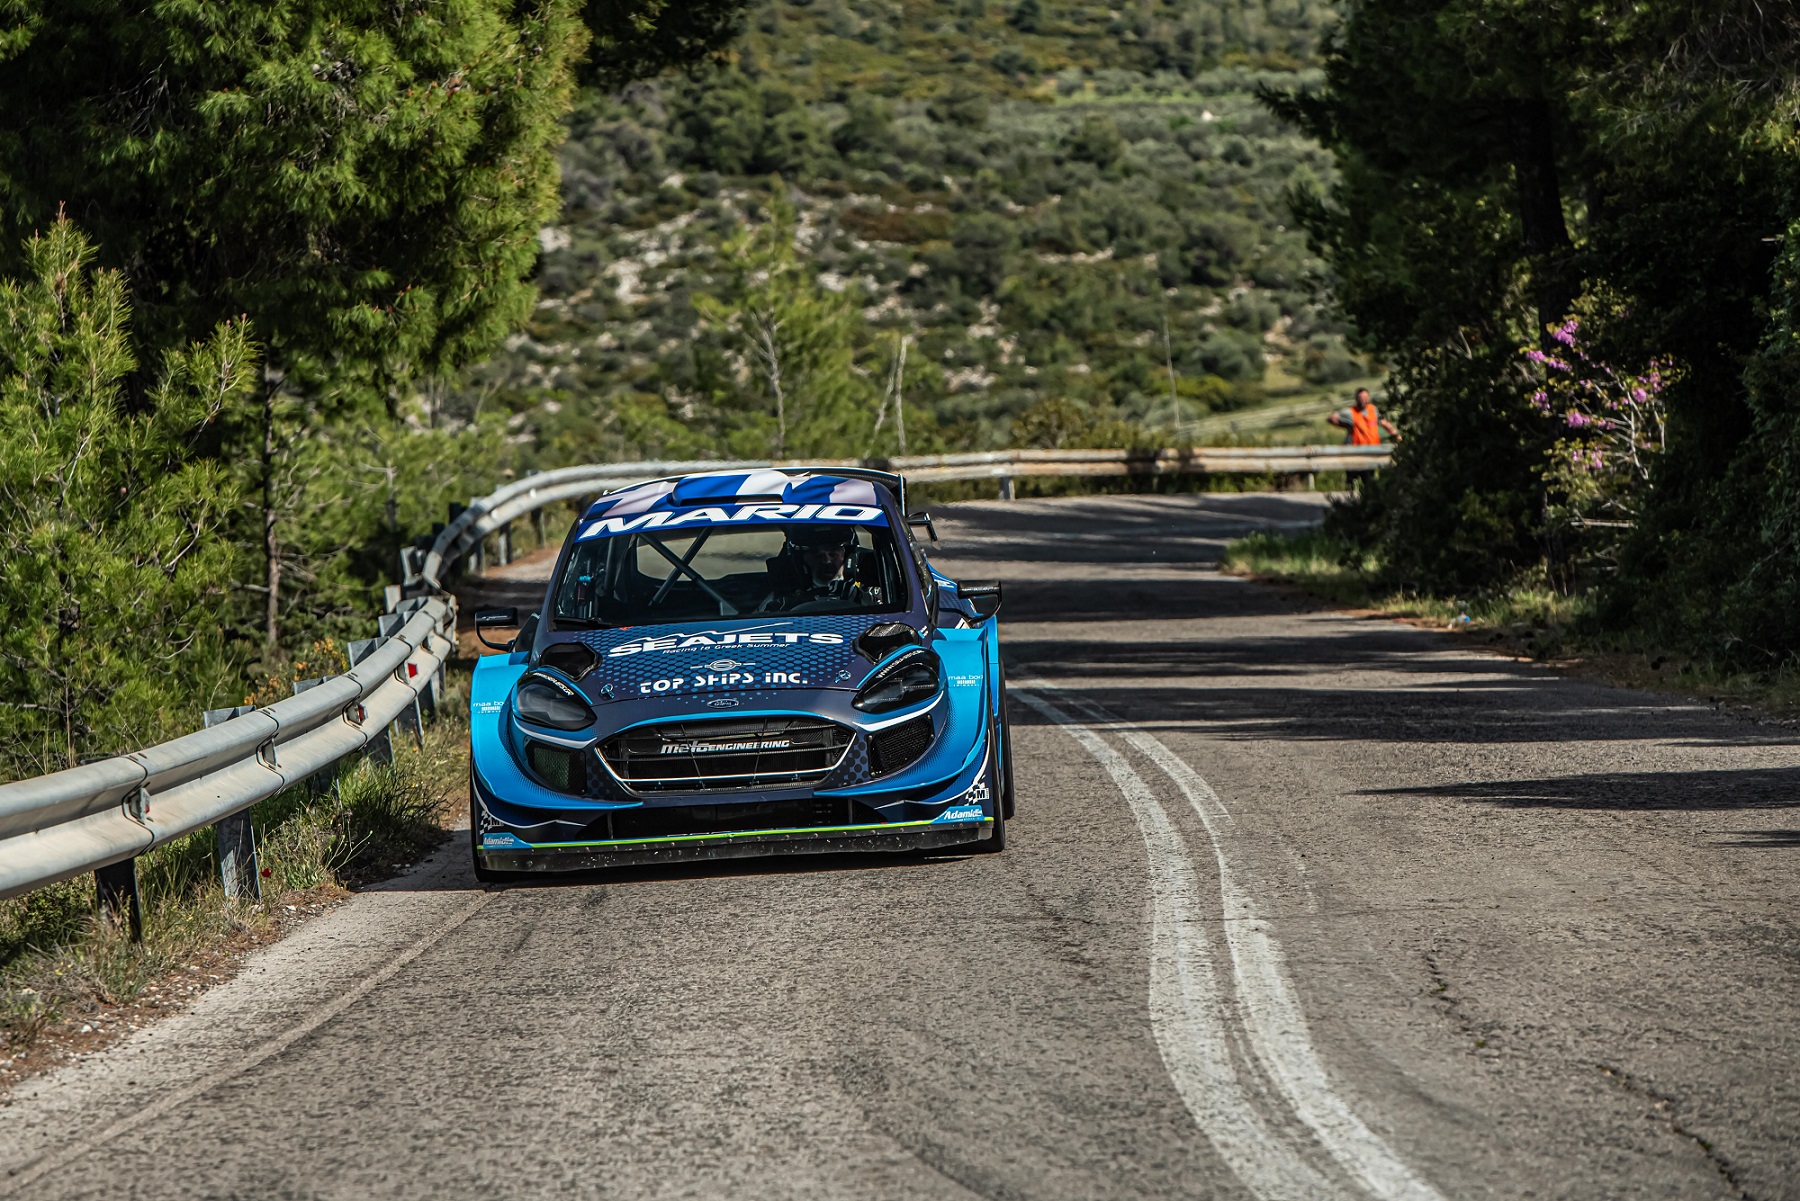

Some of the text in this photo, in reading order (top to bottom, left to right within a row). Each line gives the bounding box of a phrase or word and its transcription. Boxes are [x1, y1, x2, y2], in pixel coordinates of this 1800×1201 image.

[579, 505, 884, 539] MARIO
[608, 632, 843, 657] SEAJETS
[662, 646, 697, 654] Racing
